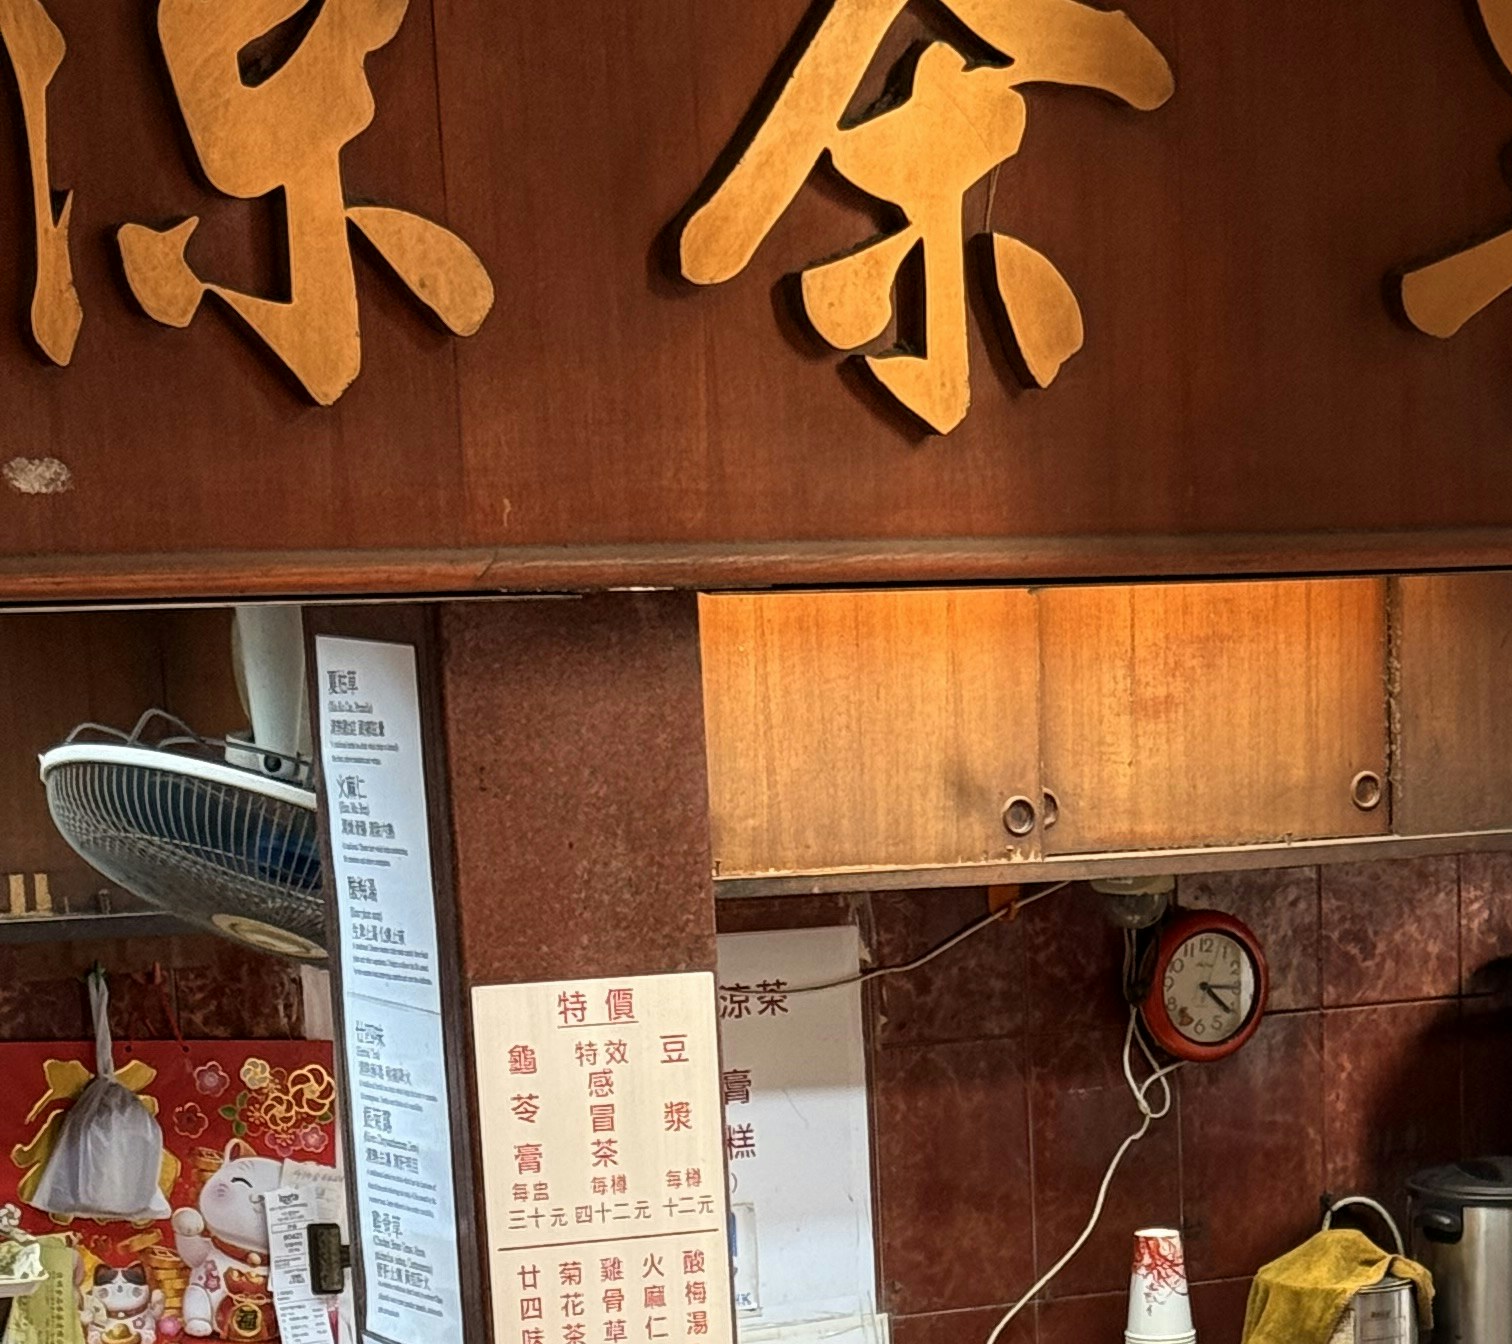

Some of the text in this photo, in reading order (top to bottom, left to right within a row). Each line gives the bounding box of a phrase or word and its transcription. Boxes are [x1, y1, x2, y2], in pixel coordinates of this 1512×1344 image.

[1199, 938, 1214, 953] 12
[558, 988, 635, 1023] 特價
[1193, 1019, 1205, 1035] 6
[1211, 1014, 1223, 1031] 5
[659, 1034, 692, 1131] 豆漿
[508, 1044, 543, 1174] 龜苓膏
[508, 1207, 568, 1230] 三十元
[575, 1200, 652, 1225] 四十二元
[662, 1195, 714, 1219] 十二元
[600, 1257, 627, 1344] 雞骨草
[641, 1253, 669, 1340] 火麻仁
[683, 1250, 708, 1335] 酸梅湯
